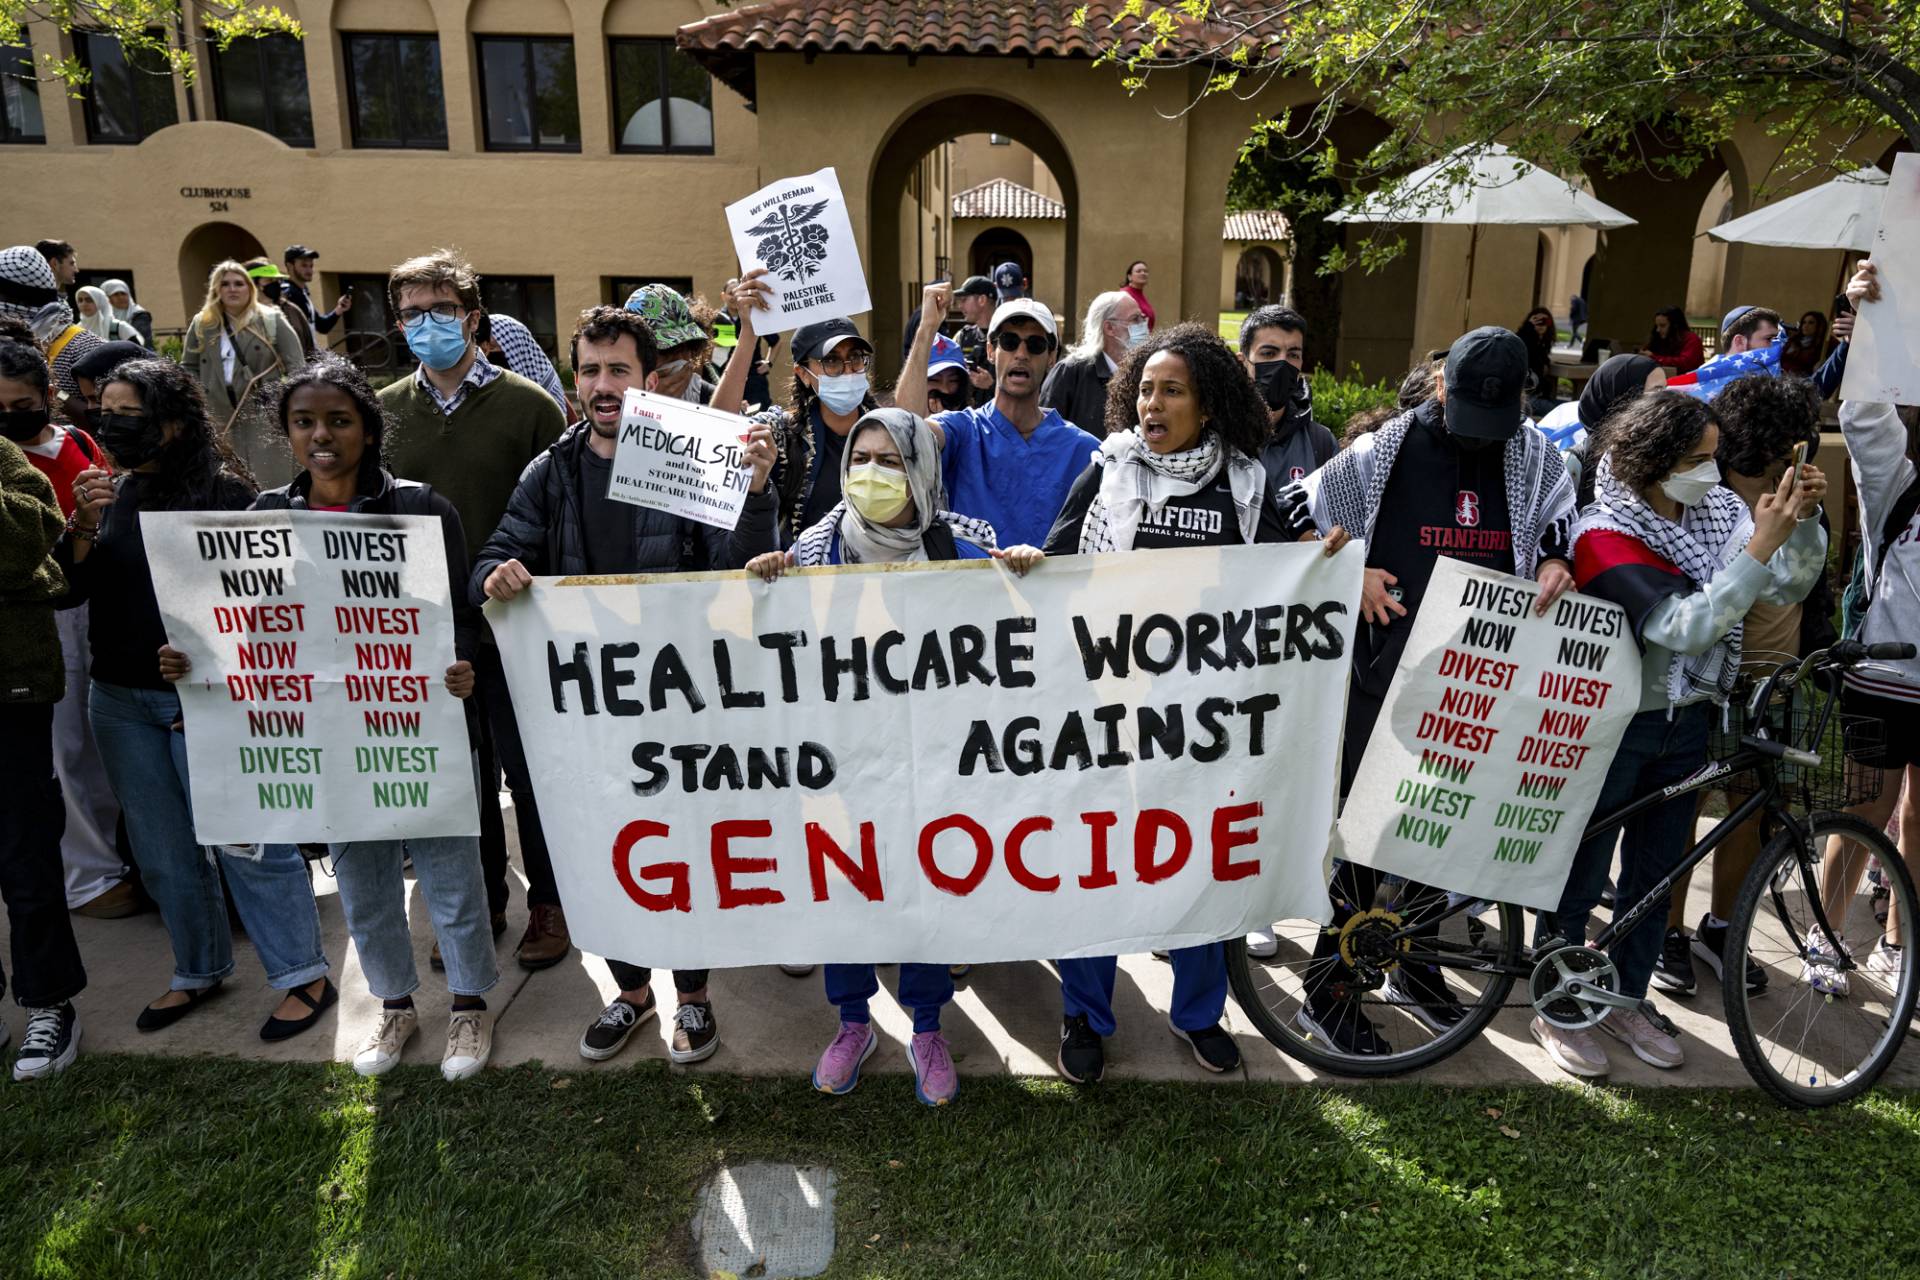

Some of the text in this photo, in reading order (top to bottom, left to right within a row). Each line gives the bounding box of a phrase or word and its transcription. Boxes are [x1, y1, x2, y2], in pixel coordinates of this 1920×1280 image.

[180, 187, 252, 199] CLUBHOUSE
[209, 201, 229, 213] 524
[749, 186, 815, 216] WE WILL REMAIN
[781, 293, 835, 313] WILL BE FREE
[783, 283, 828, 302] PALESTINE
[638, 409, 655, 419] am
[621, 423, 752, 470] MEDICAL STU
[648, 468, 719, 493] STOP KILLING
[665, 459, 685, 472] and
[691, 466, 706, 477] say
[616, 475, 687, 499] HEALTHCARE
[689, 491, 737, 513] WORKERS.
[1138, 505, 1222, 534] NFORD
[197, 529, 292, 561] DIVEST
[323, 530, 407, 562] DIVEST
[1174, 530, 1206, 540] SPORTS
[1420, 526, 1511, 550] STANFORD
[220, 568, 283, 598] NOW
[341, 569, 400, 599] NOW
[1459, 578, 1537, 619] DIVEST
[213, 604, 305, 634] DIVEST
[335, 606, 420, 635] DIVEST
[1554, 599, 1624, 638] DIVEST
[1461, 617, 1516, 654] NOW
[237, 641, 297, 670] NOW
[355, 643, 412, 670] NOW
[547, 601, 1347, 716] HEALTHCARE WORKERS
[1557, 637, 1609, 672] NOW
[1438, 649, 1518, 691] DIVEST
[227, 674, 314, 702] DIVEST
[345, 675, 430, 702] DIVEST
[1538, 671, 1612, 709] DIVEST
[1439, 687, 1496, 721] NOW
[247, 710, 304, 738] NOW
[364, 710, 420, 737] NOW
[1416, 711, 1499, 754] DIVEST
[1538, 708, 1591, 740] NOW
[239, 746, 323, 774] DIVEST
[355, 746, 439, 773] DIVEST
[631, 693, 1280, 797] STAND AGAINST
[1517, 735, 1591, 771] DIVEST
[1418, 748, 1475, 785] NOW
[1663, 764, 1732, 797] Brentwood
[258, 783, 313, 809] NOW
[373, 781, 429, 808] NOW
[1394, 778, 1476, 820] DIVEST
[1516, 771, 1567, 801] NOW
[1395, 813, 1452, 849] NOW
[1494, 802, 1565, 834] DIVEST
[612, 801, 1263, 912] GENOCIDE
[1493, 836, 1543, 864] NOW
